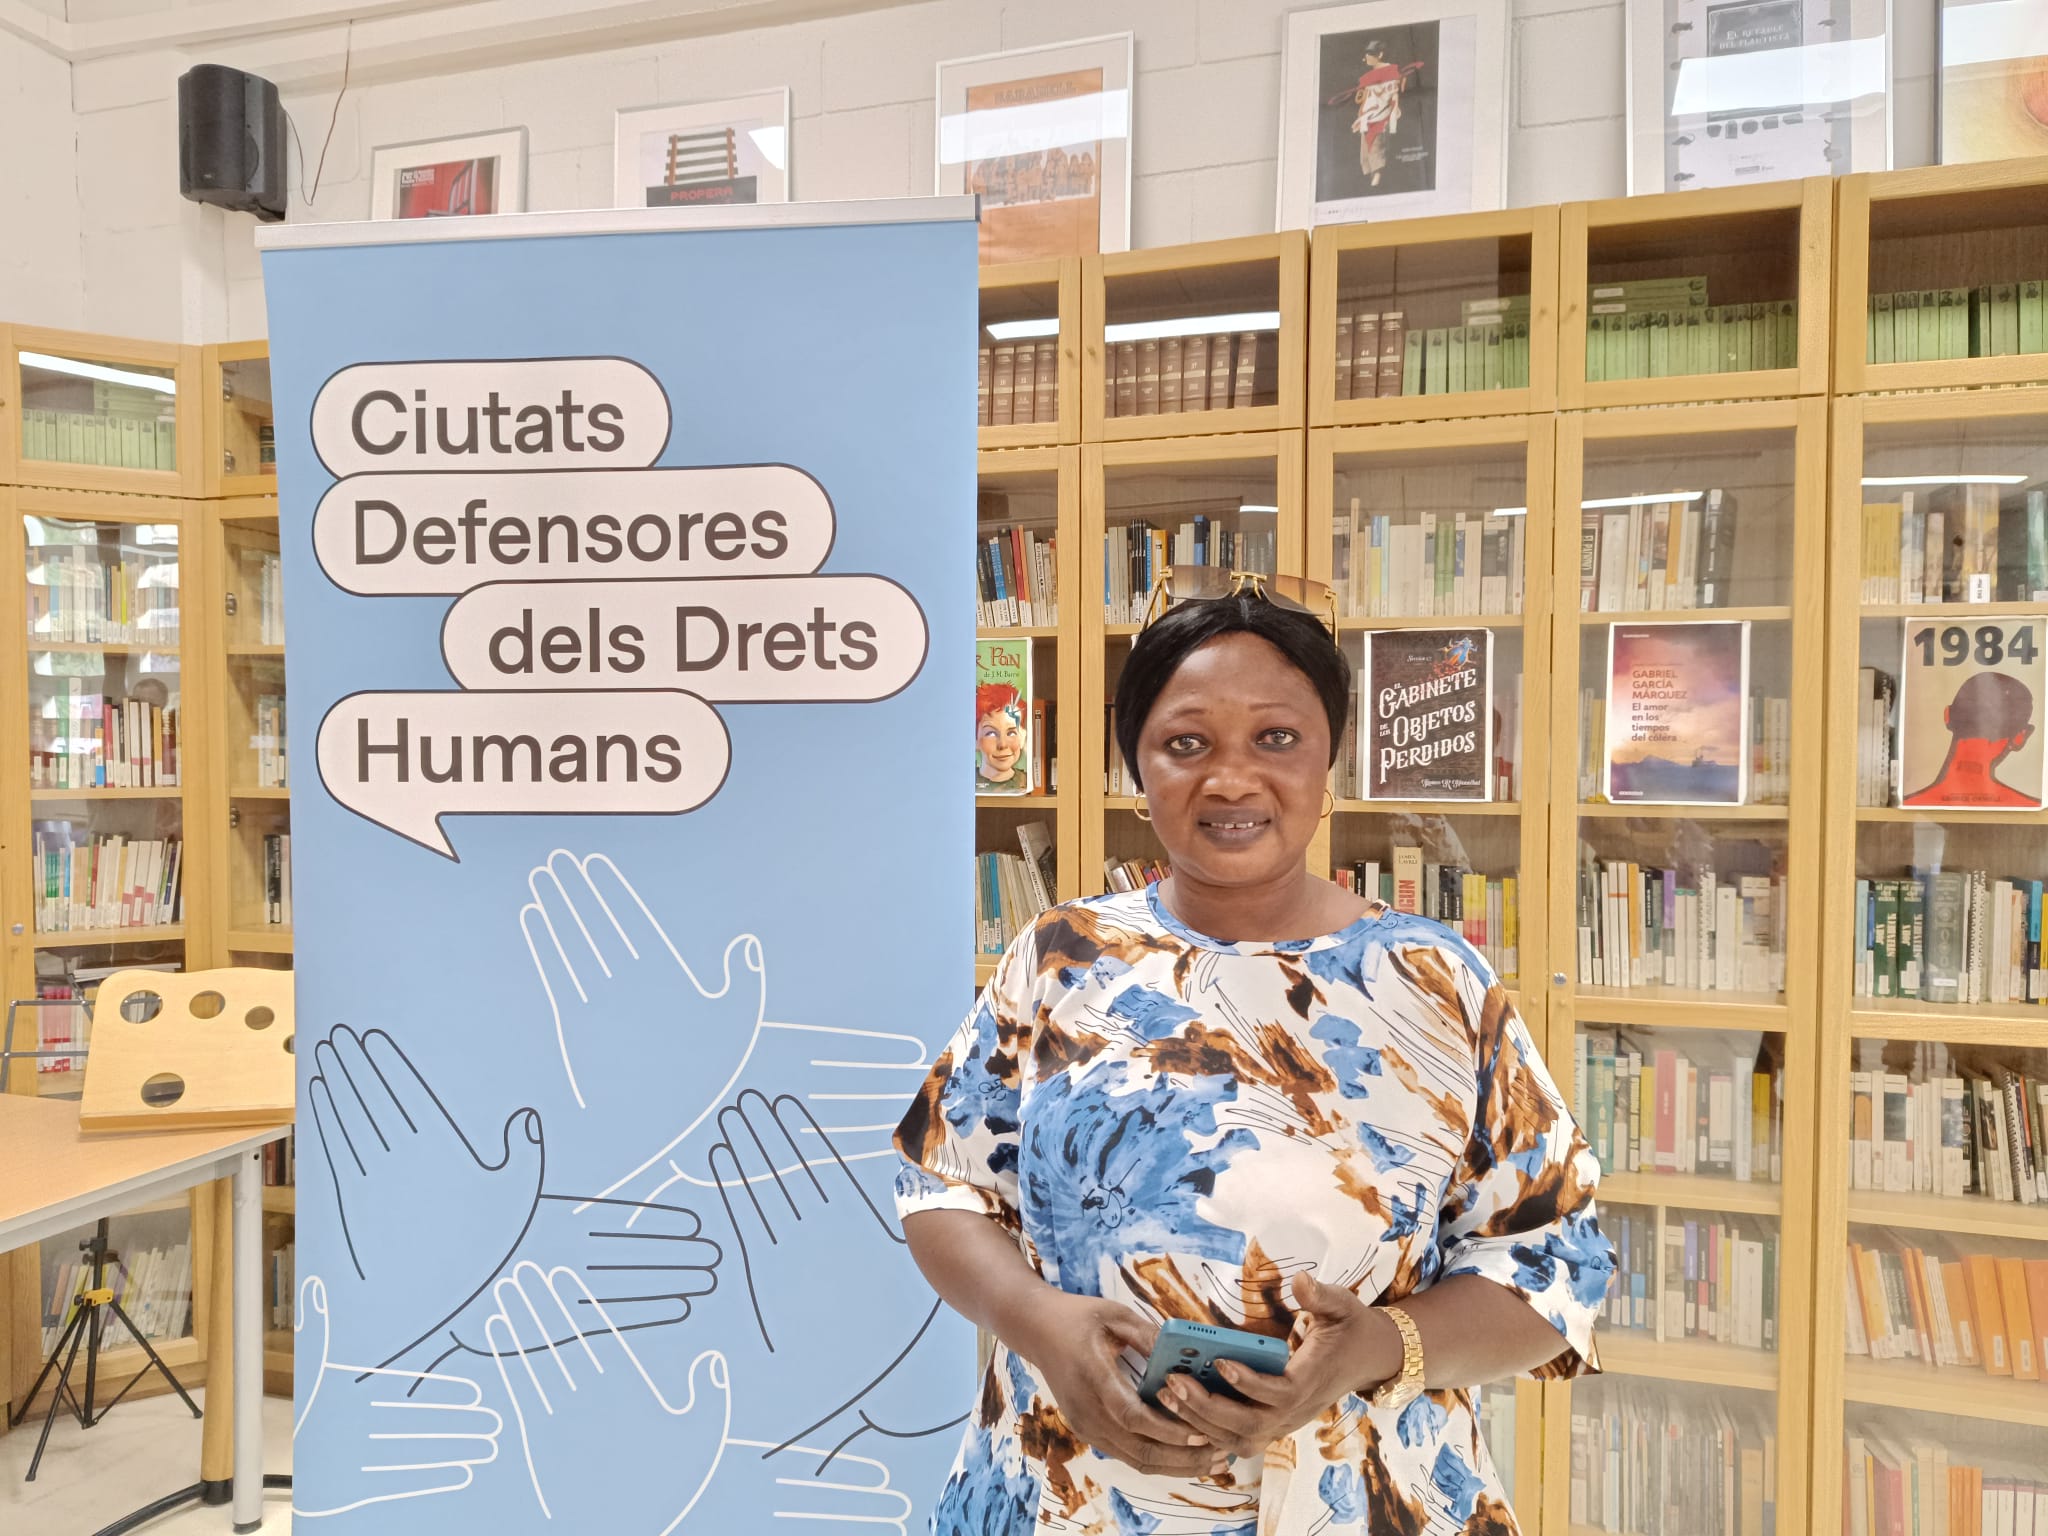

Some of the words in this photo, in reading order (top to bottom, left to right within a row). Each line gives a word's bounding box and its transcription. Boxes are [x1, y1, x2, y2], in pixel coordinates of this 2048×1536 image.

[351, 388, 626, 456] Ciutats
[354, 498, 789, 566] Defensores
[488, 606, 646, 675] dels
[675, 605, 879, 672] Drets
[1913, 625, 2039, 667] 1984
[1379, 668, 1477, 719] GABINETE
[1632, 670, 1678, 679] GABRIEL
[1632, 679, 1674, 689] GARCÍA
[1632, 689, 1688, 699] MÁRQUEZ
[1393, 700, 1477, 747] OBJETOS
[1632, 703, 1641, 711] El
[1632, 723, 1670, 733] tiempos
[1645, 713, 1659, 721] los
[357, 716, 682, 784] Humans
[1380, 731, 1476, 785] PERDIDOS
[1632, 733, 1646, 742] del
